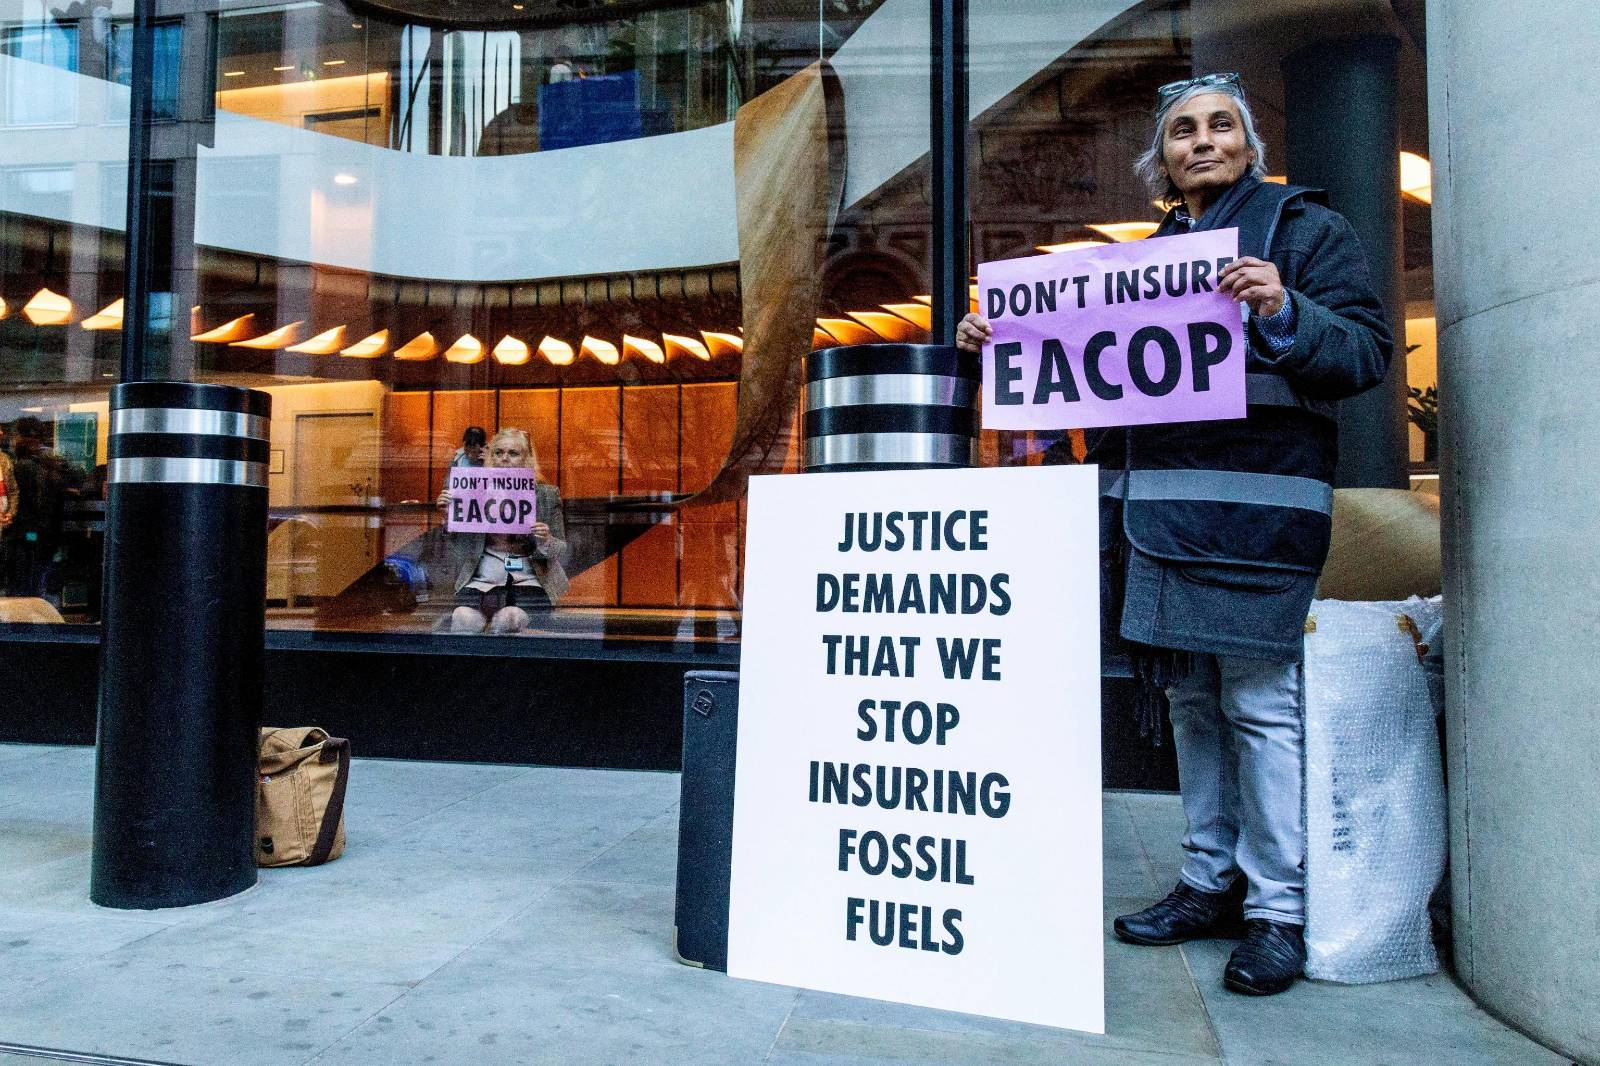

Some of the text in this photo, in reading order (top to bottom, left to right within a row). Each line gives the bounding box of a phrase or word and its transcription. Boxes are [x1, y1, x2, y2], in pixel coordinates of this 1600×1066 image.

[987, 275, 1090, 320] DON'T
[993, 321, 1233, 406] EACOP
[452, 477, 535, 491] DON'T INSURE
[452, 498, 532, 525] EACOP
[838, 509, 988, 553] JUSTICE
[815, 572, 1012, 616] DEMANDS
[822, 634, 1002, 681] THAT WE
[857, 698, 960, 746] STOP
[808, 760, 1011, 819] INSURING
[838, 828, 975, 886] FOSSIL
[846, 896, 964, 956] FUELS
